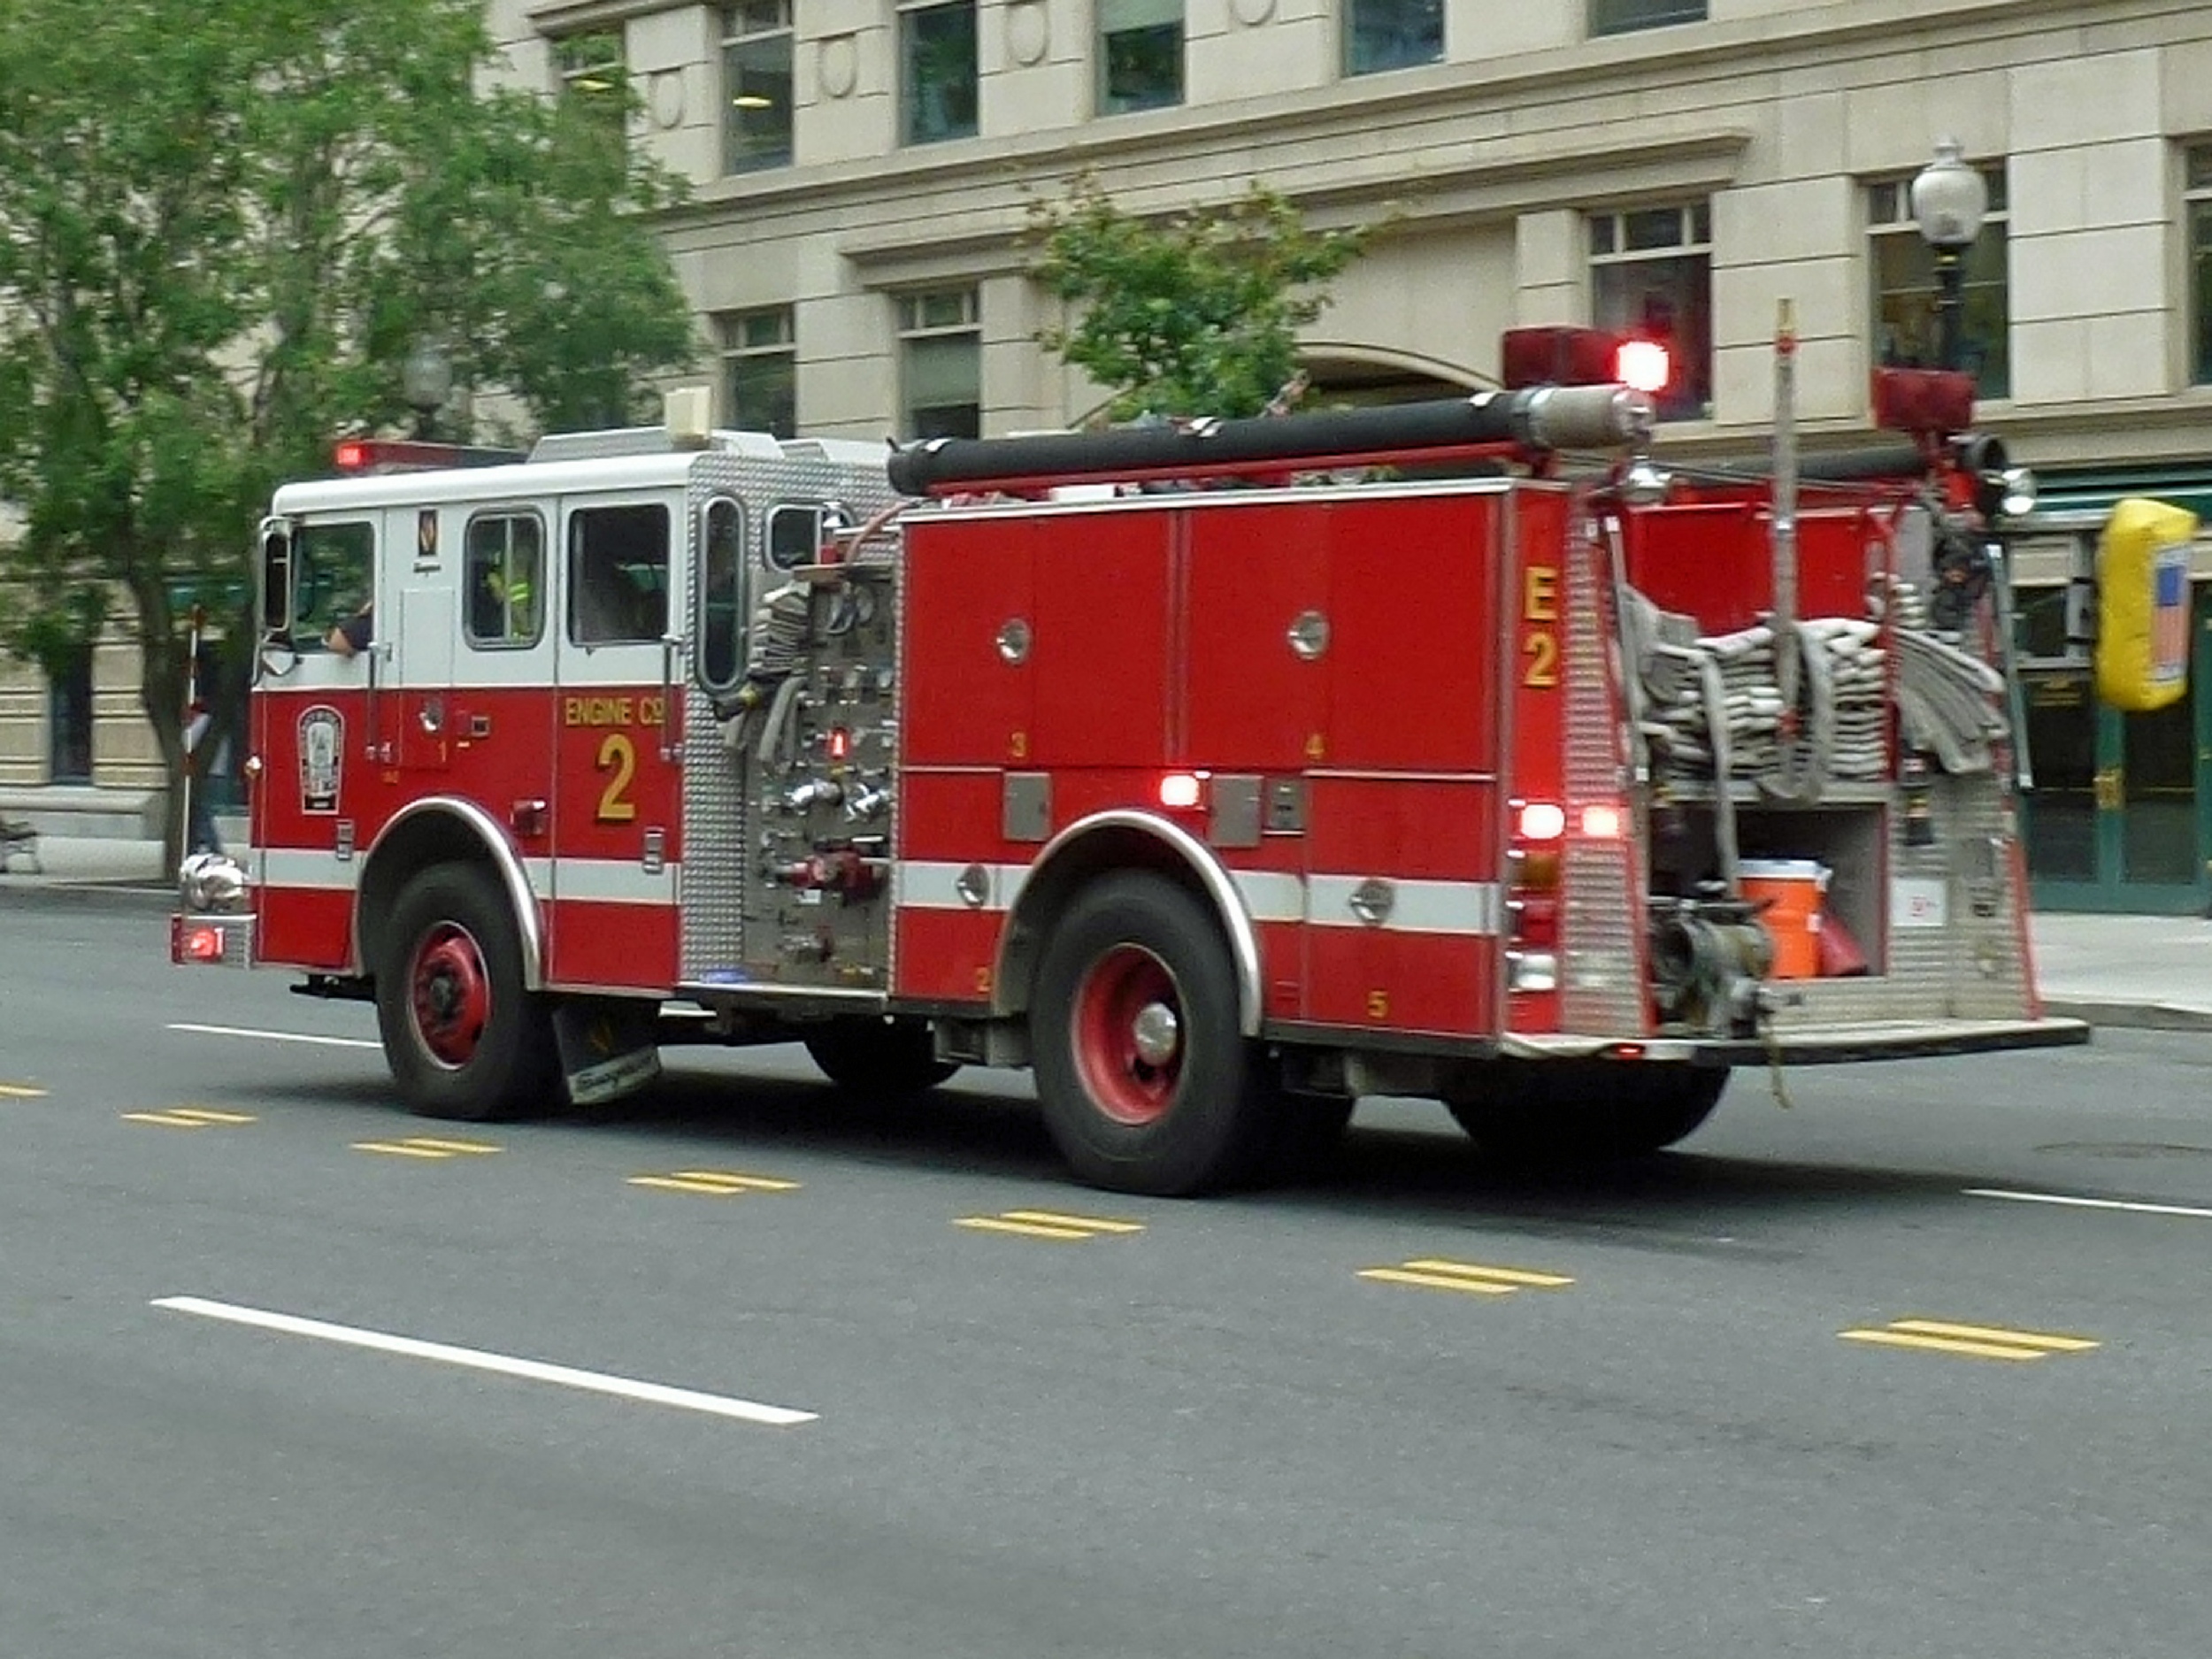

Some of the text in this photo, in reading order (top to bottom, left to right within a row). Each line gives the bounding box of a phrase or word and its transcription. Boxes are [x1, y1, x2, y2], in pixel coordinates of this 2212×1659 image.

[1525, 565, 1559, 619] E
[1521, 632, 1560, 686] 2
[565, 697, 633, 725] ENGINE
[1010, 731, 1026, 757] 3
[1305, 733, 1325, 760] 4
[598, 733, 636, 819] 2
[1367, 990, 1389, 1018] 5
